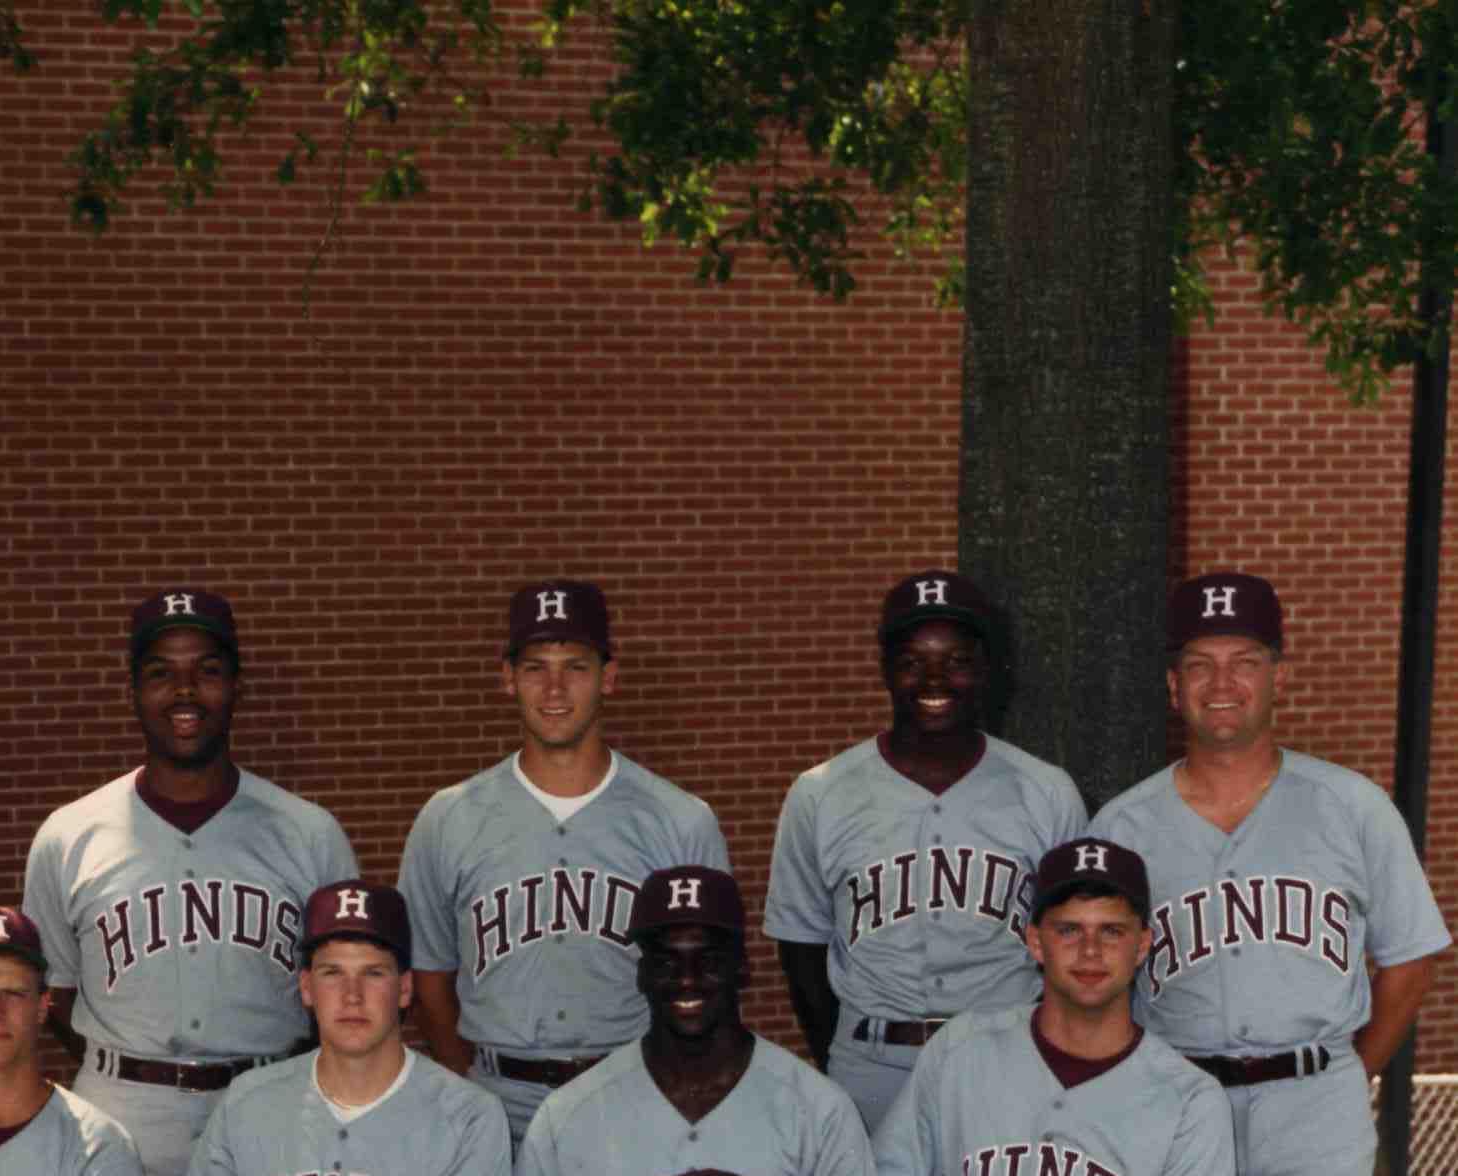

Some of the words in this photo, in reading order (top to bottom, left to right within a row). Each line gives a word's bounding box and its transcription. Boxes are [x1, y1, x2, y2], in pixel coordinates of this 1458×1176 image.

[163, 592, 197, 617] H
[534, 588, 568, 622] H
[915, 578, 949, 605] H
[1200, 584, 1238, 618] H
[1073, 845, 1108, 873] H
[335, 888, 369, 920] H
[667, 878, 702, 910] H
[95, 879, 302, 993] HINDS
[471, 867, 642, 983] HIND
[1145, 876, 1352, 1003] HINDS
